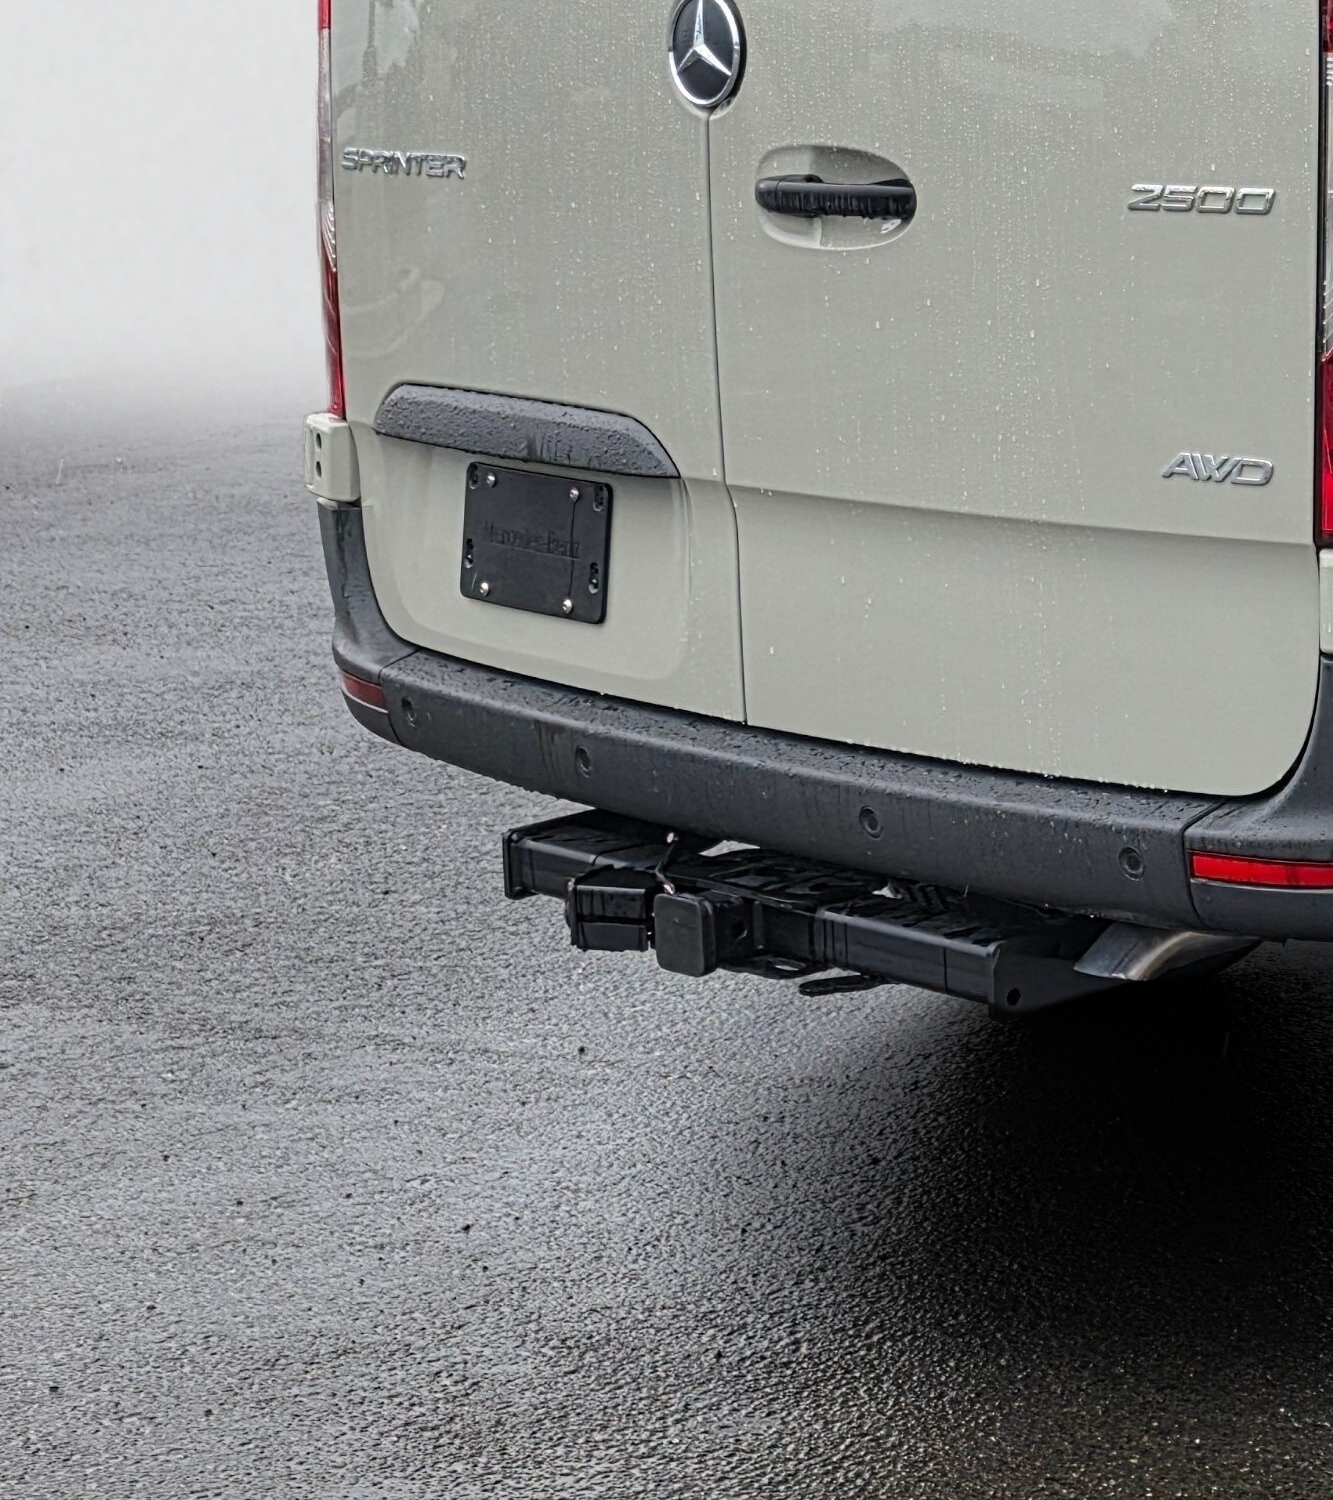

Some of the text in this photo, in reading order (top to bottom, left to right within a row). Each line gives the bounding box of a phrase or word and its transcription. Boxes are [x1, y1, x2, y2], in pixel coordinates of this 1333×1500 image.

[341, 148, 467, 180] SPRINTER
[1127, 184, 1277, 215] 2500
[1161, 452, 1274, 486] AWD
